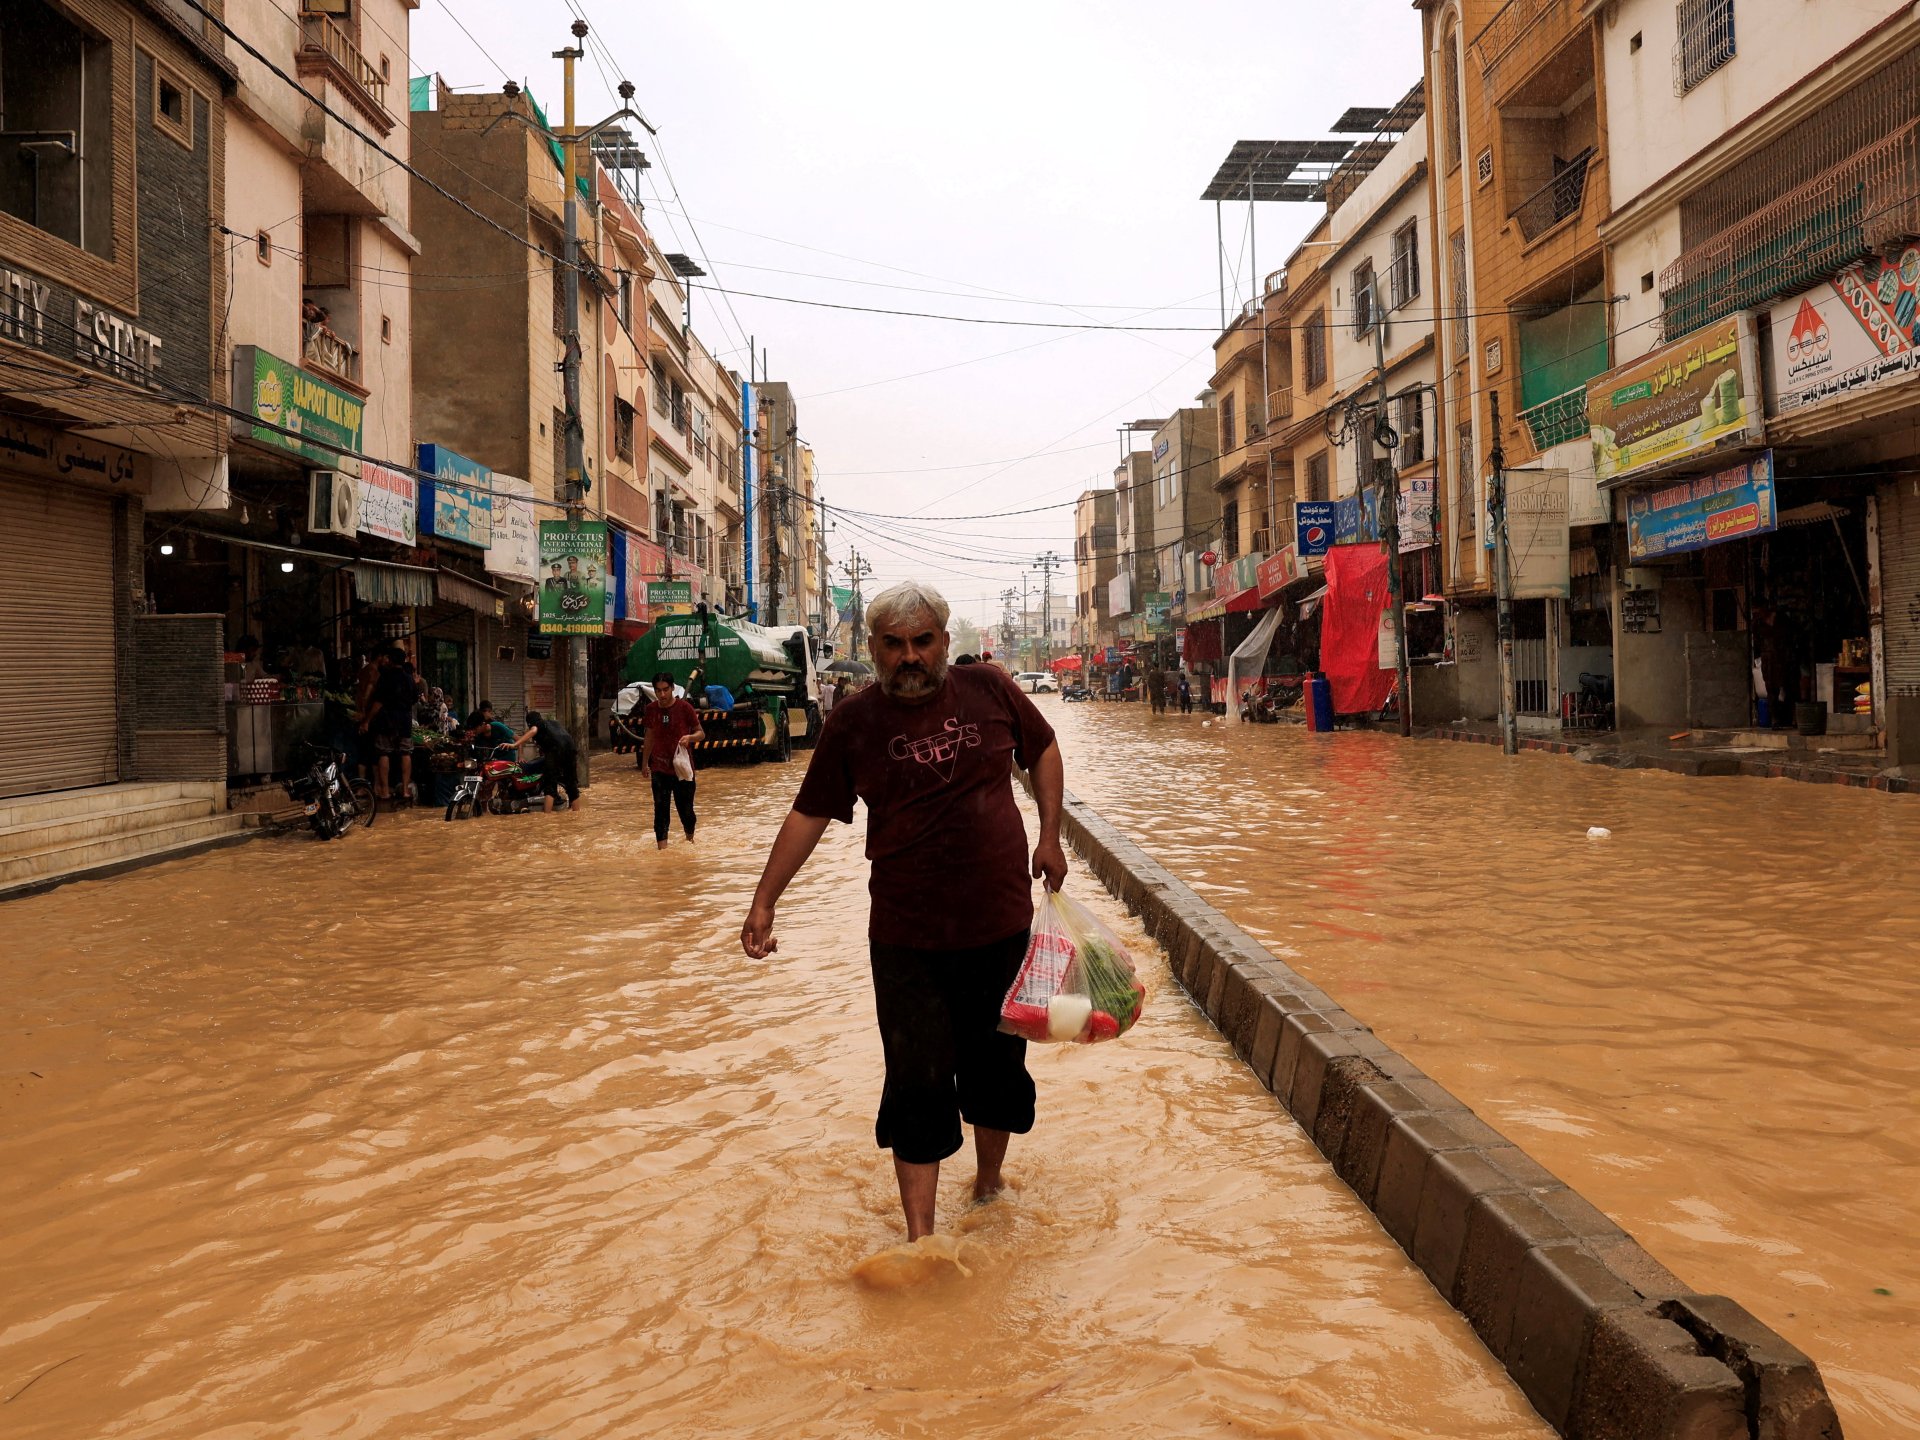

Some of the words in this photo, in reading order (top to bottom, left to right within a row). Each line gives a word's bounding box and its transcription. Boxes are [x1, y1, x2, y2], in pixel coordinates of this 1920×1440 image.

[0, 268, 50, 346] ITY
[74, 299, 162, 391] ESTATE
[293, 375, 326, 418] RAJPOOT
[326, 391, 344, 426] MILK
[343, 400, 361, 433] SHOP
[543, 533, 604, 542] PROFECTUS
[657, 648, 688, 660] CANTONMENT
[660, 637, 694, 649] CANTONMENTS
[888, 717, 981, 763] GUESS
